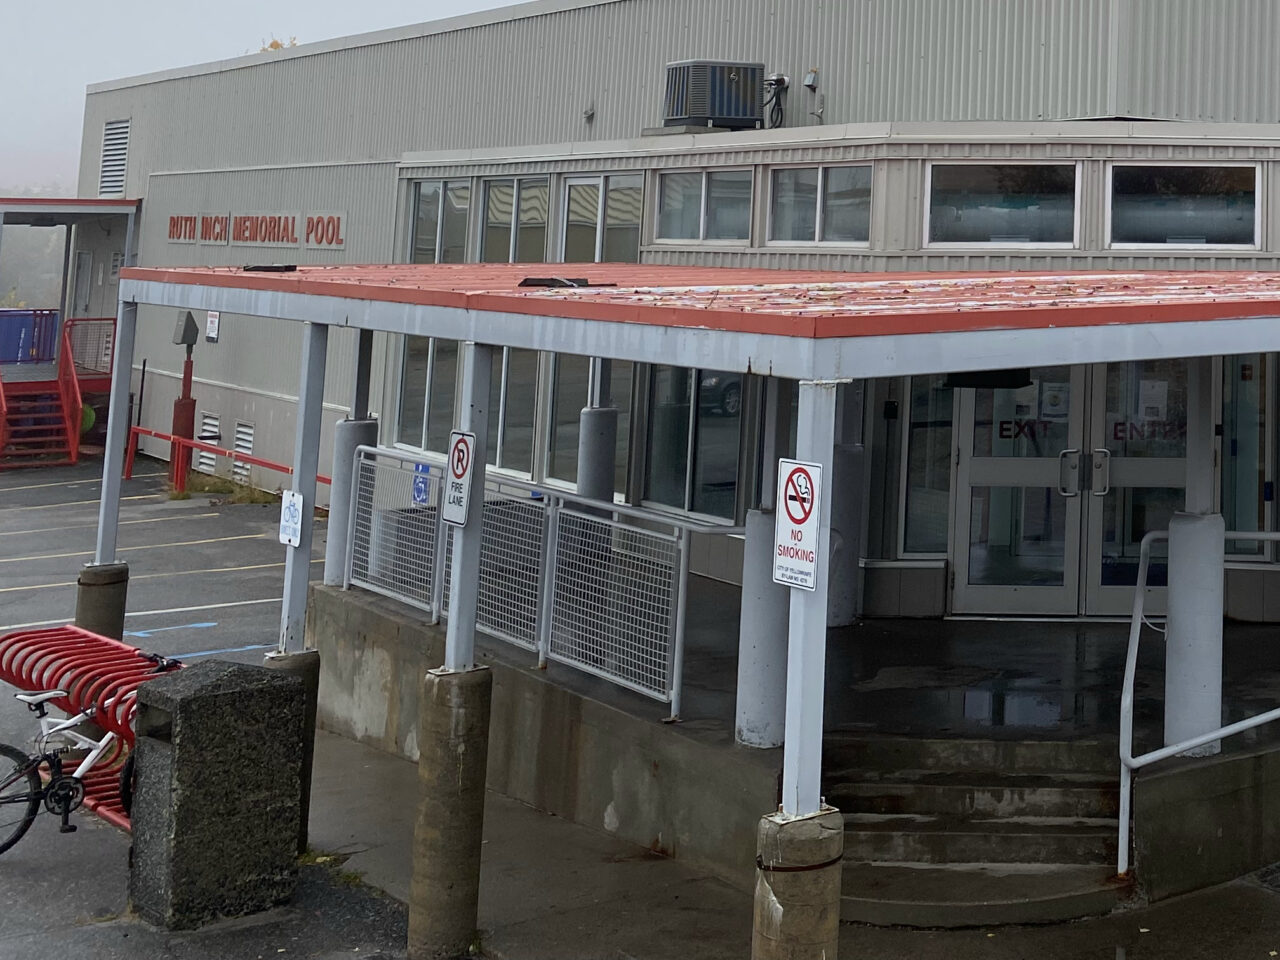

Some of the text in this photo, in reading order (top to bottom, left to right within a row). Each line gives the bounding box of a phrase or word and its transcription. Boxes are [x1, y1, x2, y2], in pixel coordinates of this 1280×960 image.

[168, 215, 344, 245] RUTH INCH MEMORIAL POOL
[1000, 419, 1050, 440] EXIT
[451, 482, 463, 493] FIRE
[448, 494, 464, 507] LANE
[791, 529, 802, 542] NO
[778, 544, 814, 562] SMOKING
